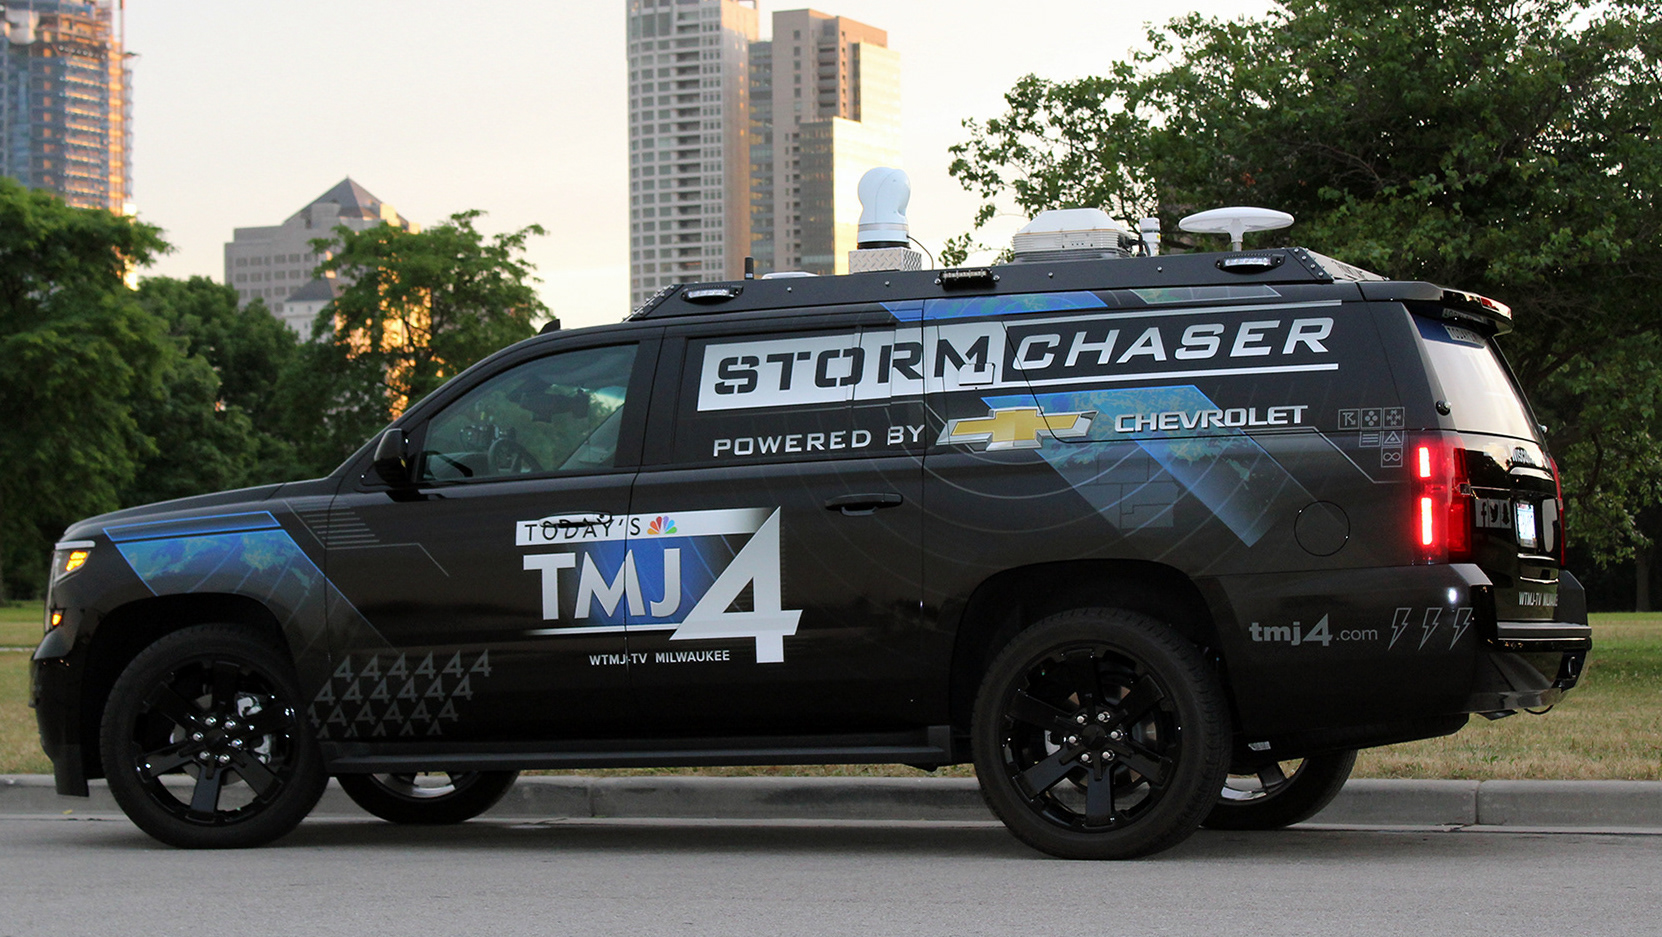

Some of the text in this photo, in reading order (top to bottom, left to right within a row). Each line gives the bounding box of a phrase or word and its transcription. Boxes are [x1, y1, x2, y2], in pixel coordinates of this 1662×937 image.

[714, 317, 1334, 395] STORM CHASER
[1114, 405, 1309, 433] CHEVROLET
[712, 424, 926, 457] POWERED BY
[524, 517, 641, 542] TODAY'S
[589, 650, 731, 666] WTMJ-TV MILWAUKEE
